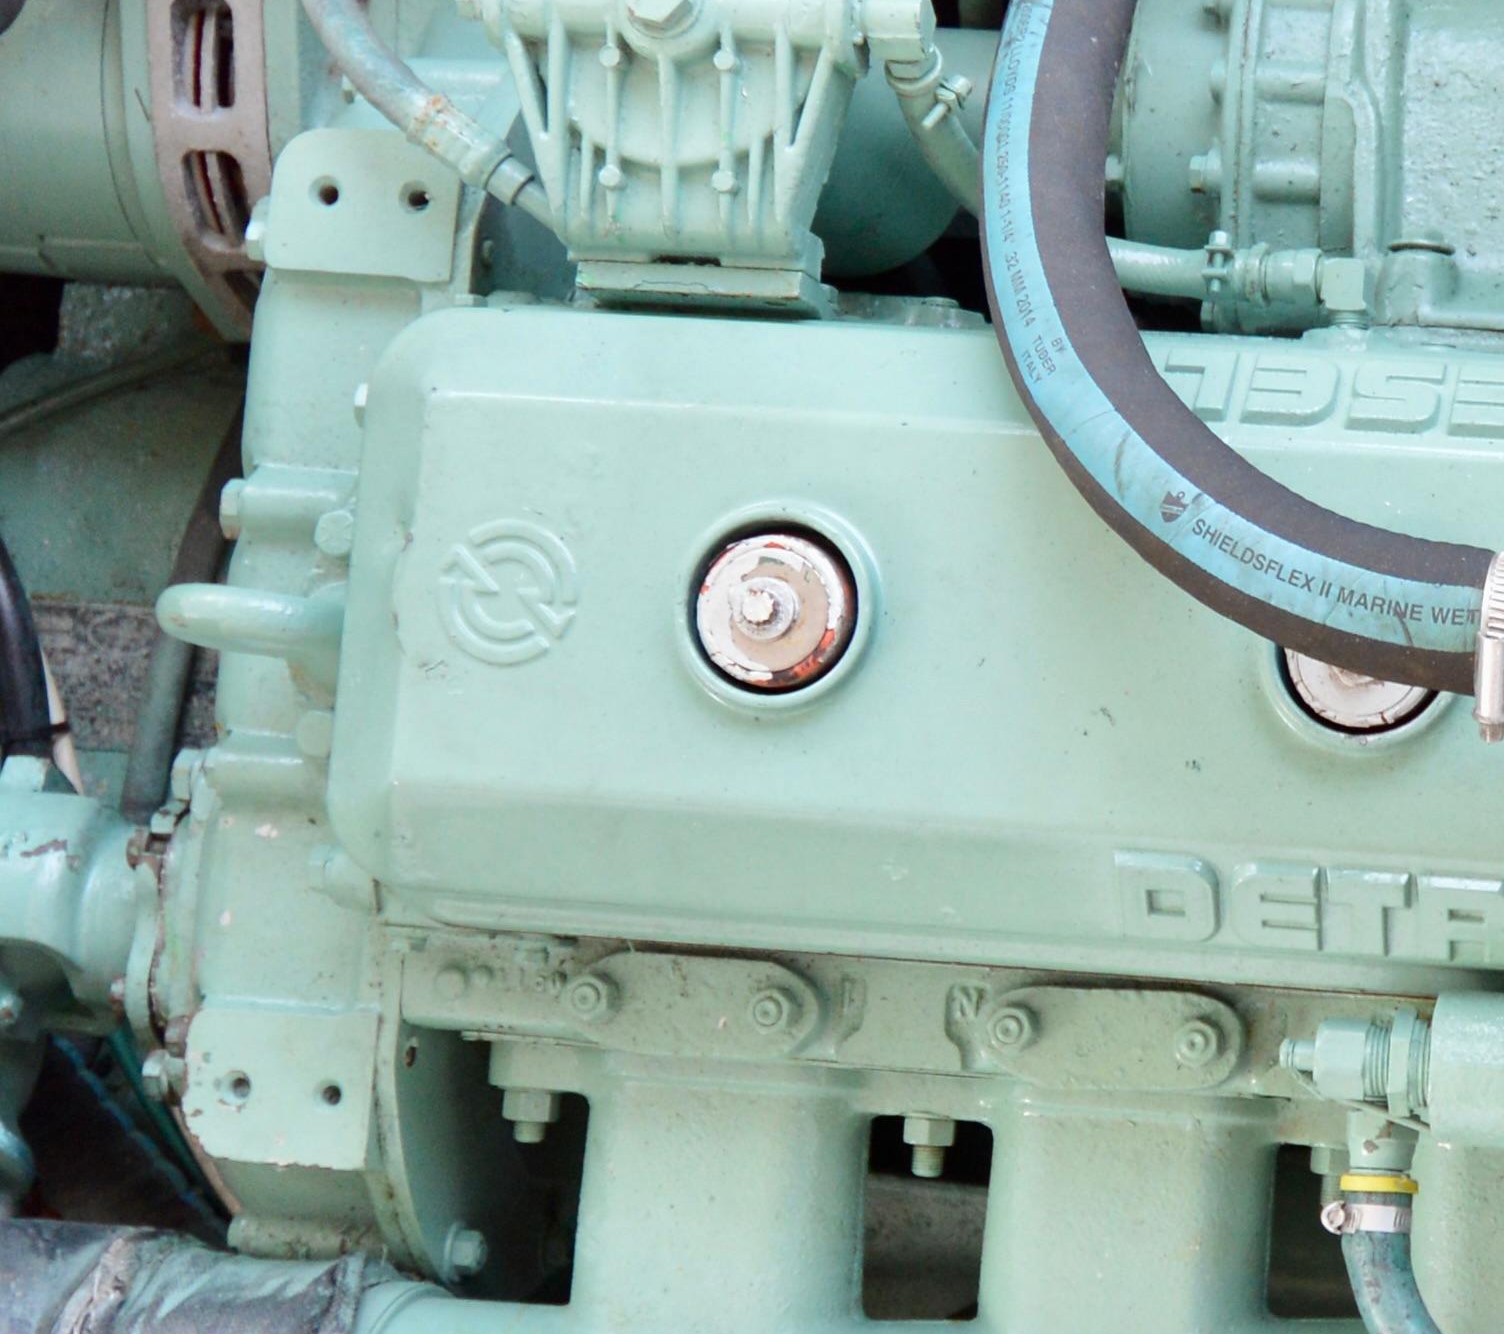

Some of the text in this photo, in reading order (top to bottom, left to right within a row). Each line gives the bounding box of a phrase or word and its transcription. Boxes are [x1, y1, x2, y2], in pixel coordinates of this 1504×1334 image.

[1016, 293, 1037, 329] 2014
[1191, 518, 1481, 626] SHIELDSFLEX II MARINE WET
